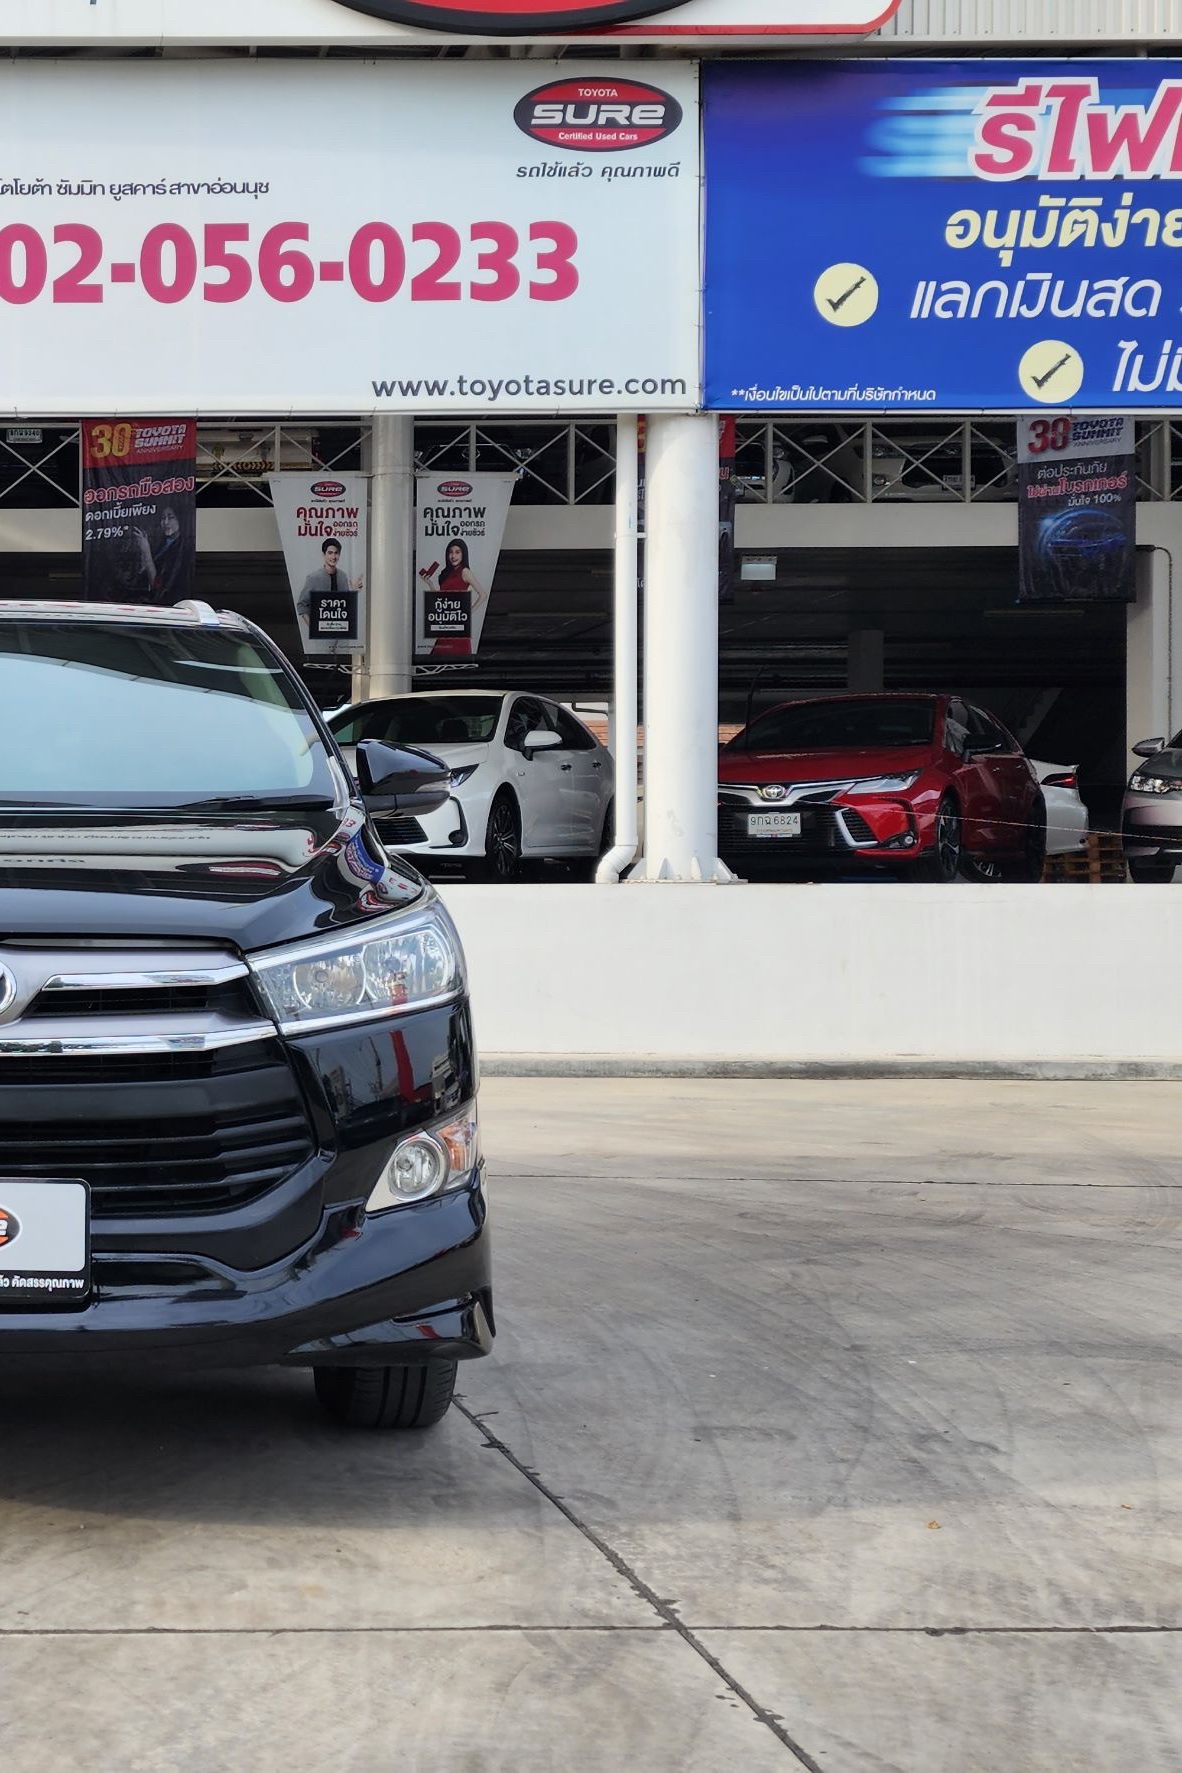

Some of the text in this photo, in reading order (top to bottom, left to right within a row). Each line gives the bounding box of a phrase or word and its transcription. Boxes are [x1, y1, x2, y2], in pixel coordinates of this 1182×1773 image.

[578, 88, 618, 97] TOYOTA
[558, 132, 638, 141] Certified Used Cars
[969, 79, 1182, 179] รีไฟ
[516, 162, 681, 182] รถใช้แล้ว คุณภาพดี
[56, 178, 105, 196] ซัมมิท
[109, 178, 166, 201] ยูสคาร์
[169, 177, 269, 200] สาขาอ่อนนุช
[910, 272, 1162, 319] แลกเงินสด
[371, 375, 687, 402] www.toyotasure.com
[134, 424, 186, 438] TOYOTA
[1072, 417, 1124, 431] TOYOTA
[91, 423, 131, 458] 30
[134, 434, 185, 448] SUMMIT
[1072, 427, 1124, 441] SUMMIT
[84, 476, 195, 504] ออกรถมือสอง
[1094, 492, 1121, 504] 100%
[296, 507, 359, 522] คุณภาพ
[423, 507, 486, 522] คุณภาพ
[298, 520, 333, 537] มั่นใจ
[425, 520, 460, 536] มั่นใจ
[320, 599, 346, 607] ราคา
[319, 608, 347, 619] โดนใจ
[773, 815, 798, 825] 6824
[11, 1274, 84, 1291] คัดสรรคุณภาพ
